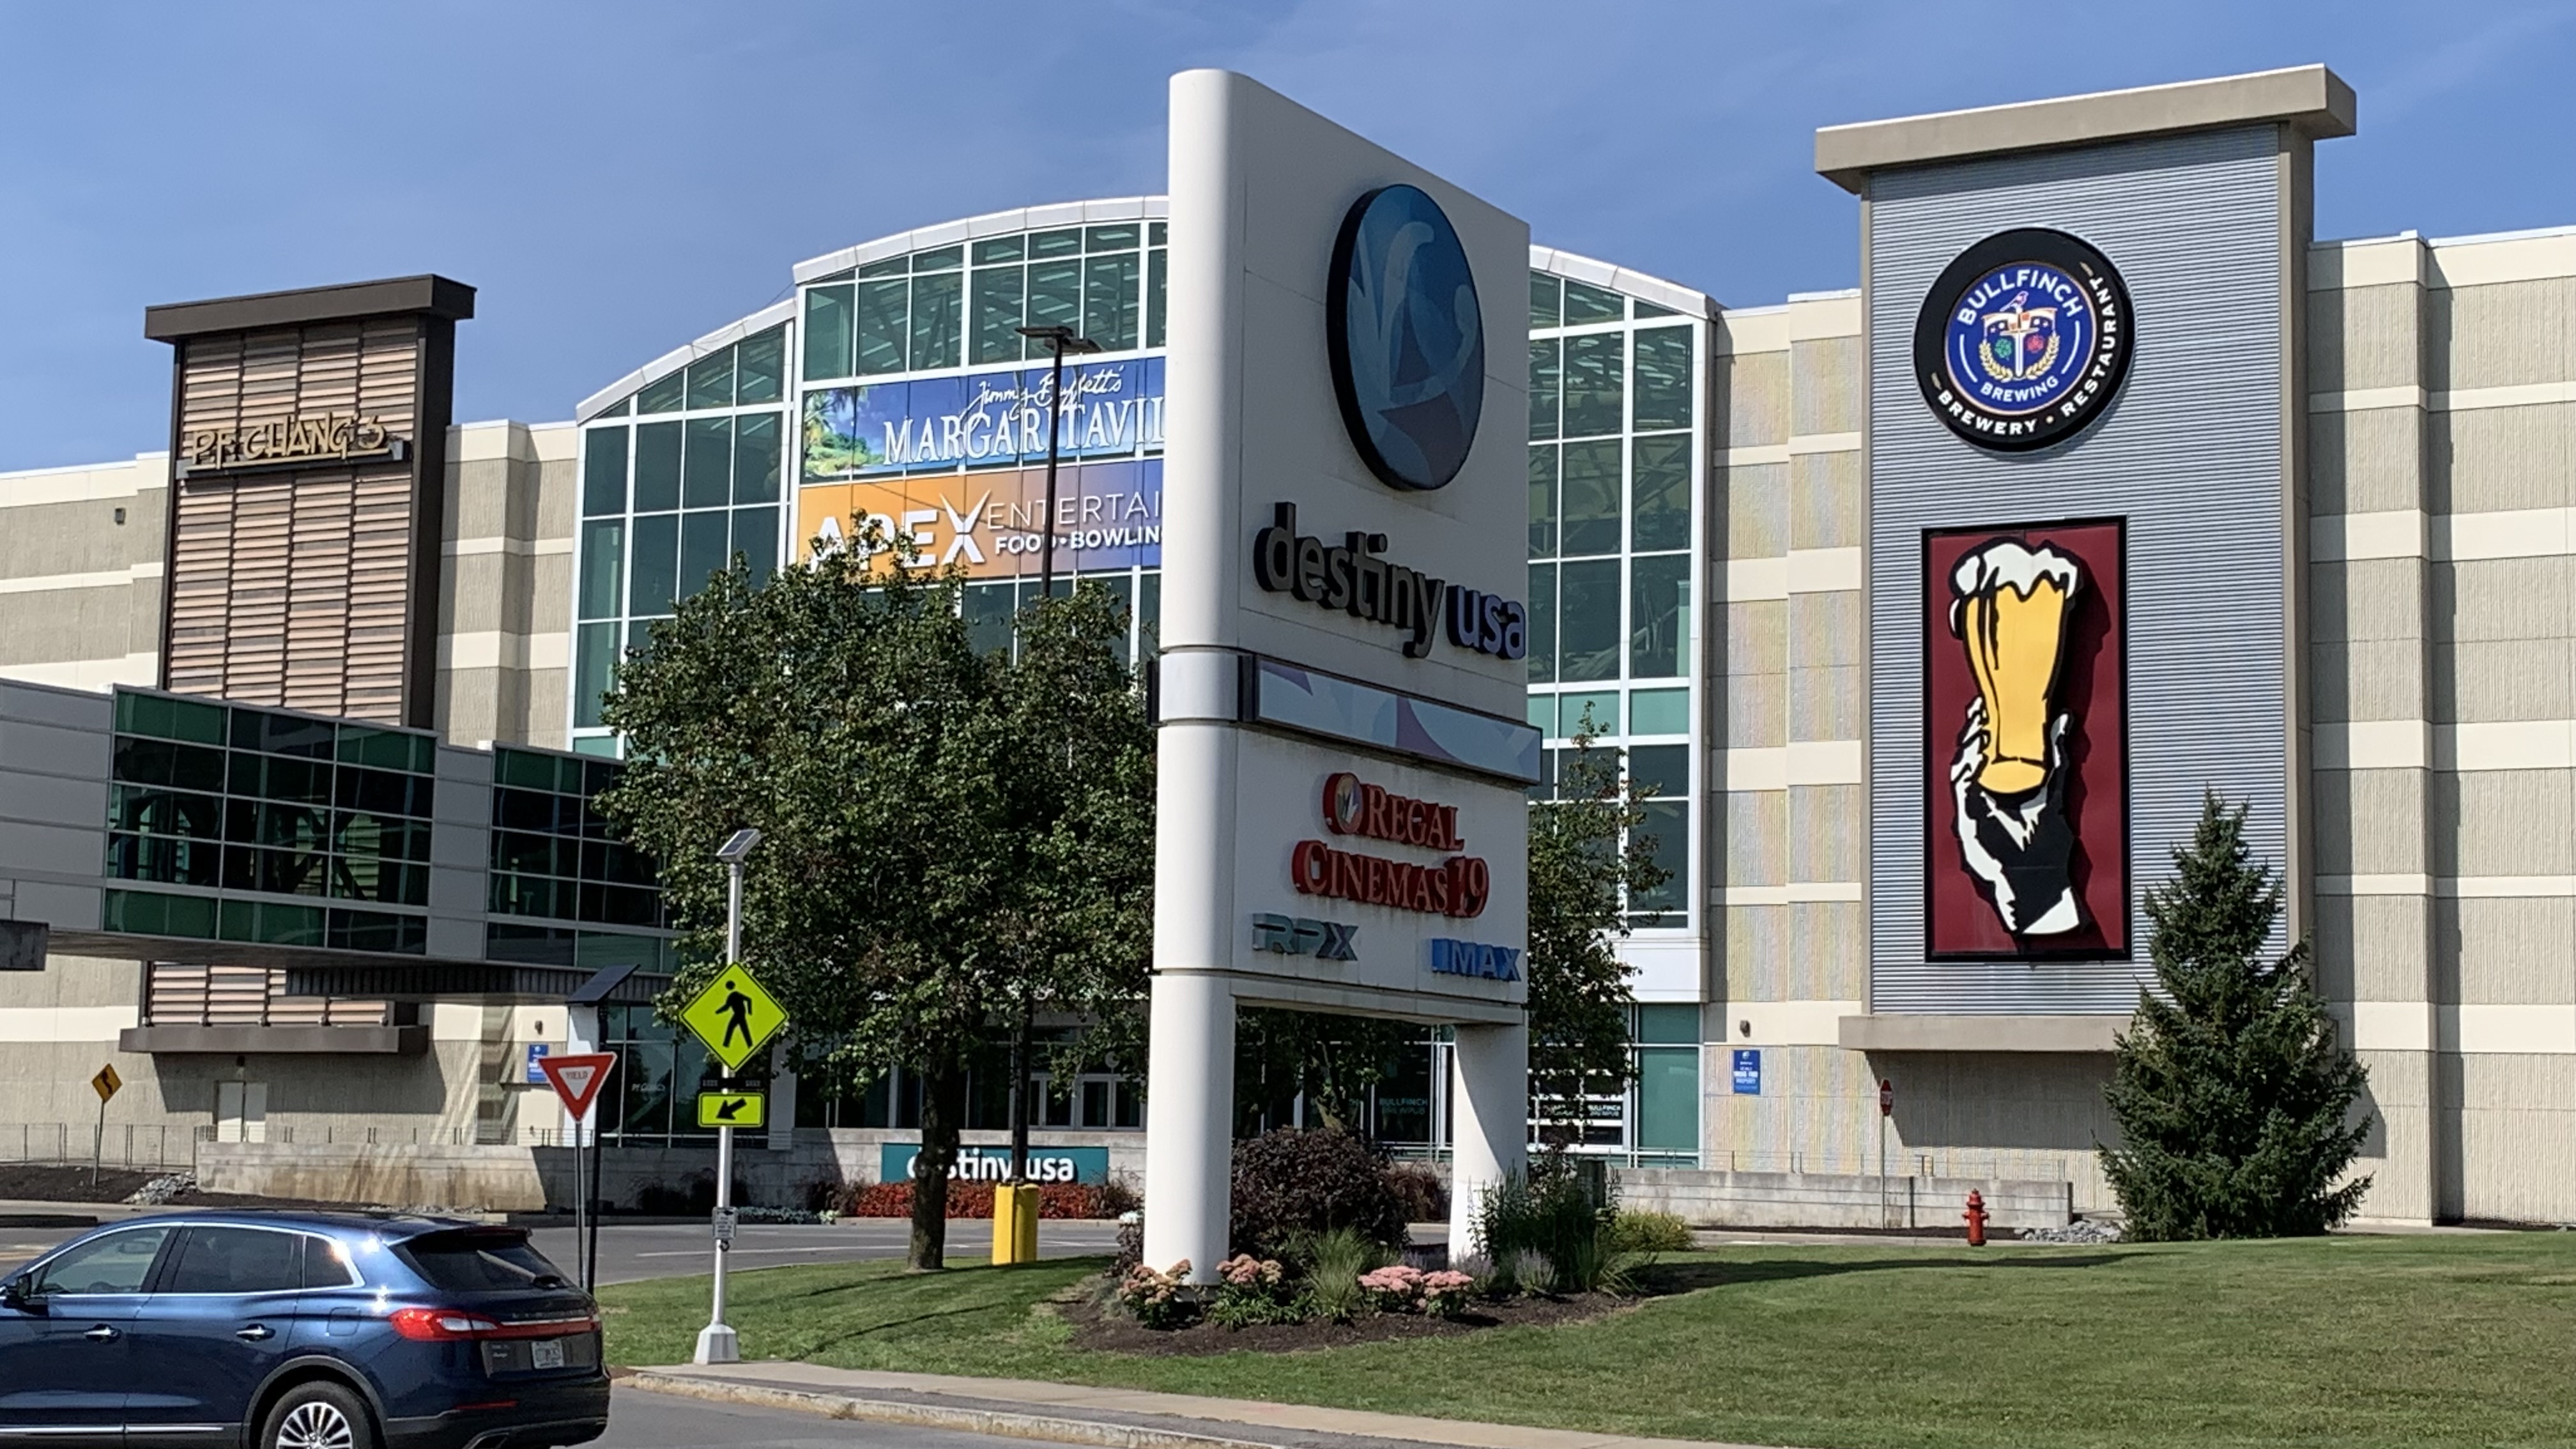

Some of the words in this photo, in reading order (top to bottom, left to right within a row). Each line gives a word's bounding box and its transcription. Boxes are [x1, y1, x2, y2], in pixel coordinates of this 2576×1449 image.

[1957, 269, 2083, 326] BULLFINCH
[1938, 389, 2038, 435] BREWERY
[2060, 277, 2117, 418] RESTAURANT
[960, 381, 1030, 422] Jimmy
[1034, 365, 1124, 409] Bffett's
[1980, 375, 2059, 402] BREWING
[243, 412, 386, 459] CHANG'S
[806, 489, 991, 574] APEX
[995, 533, 1057, 555] FOO
[1070, 525, 1163, 550] BOWLIN
[1254, 502, 1445, 659] destiny
[1446, 585, 1526, 660] usa
[1292, 839, 1448, 914] CINEMAS
[1447, 855, 1490, 918] 19
[1252, 913, 1359, 961] RPX
[1432, 939, 1522, 982] IMAX
[566, 1071, 588, 1080] YIELD
[1025, 1157, 1074, 1181] usa
